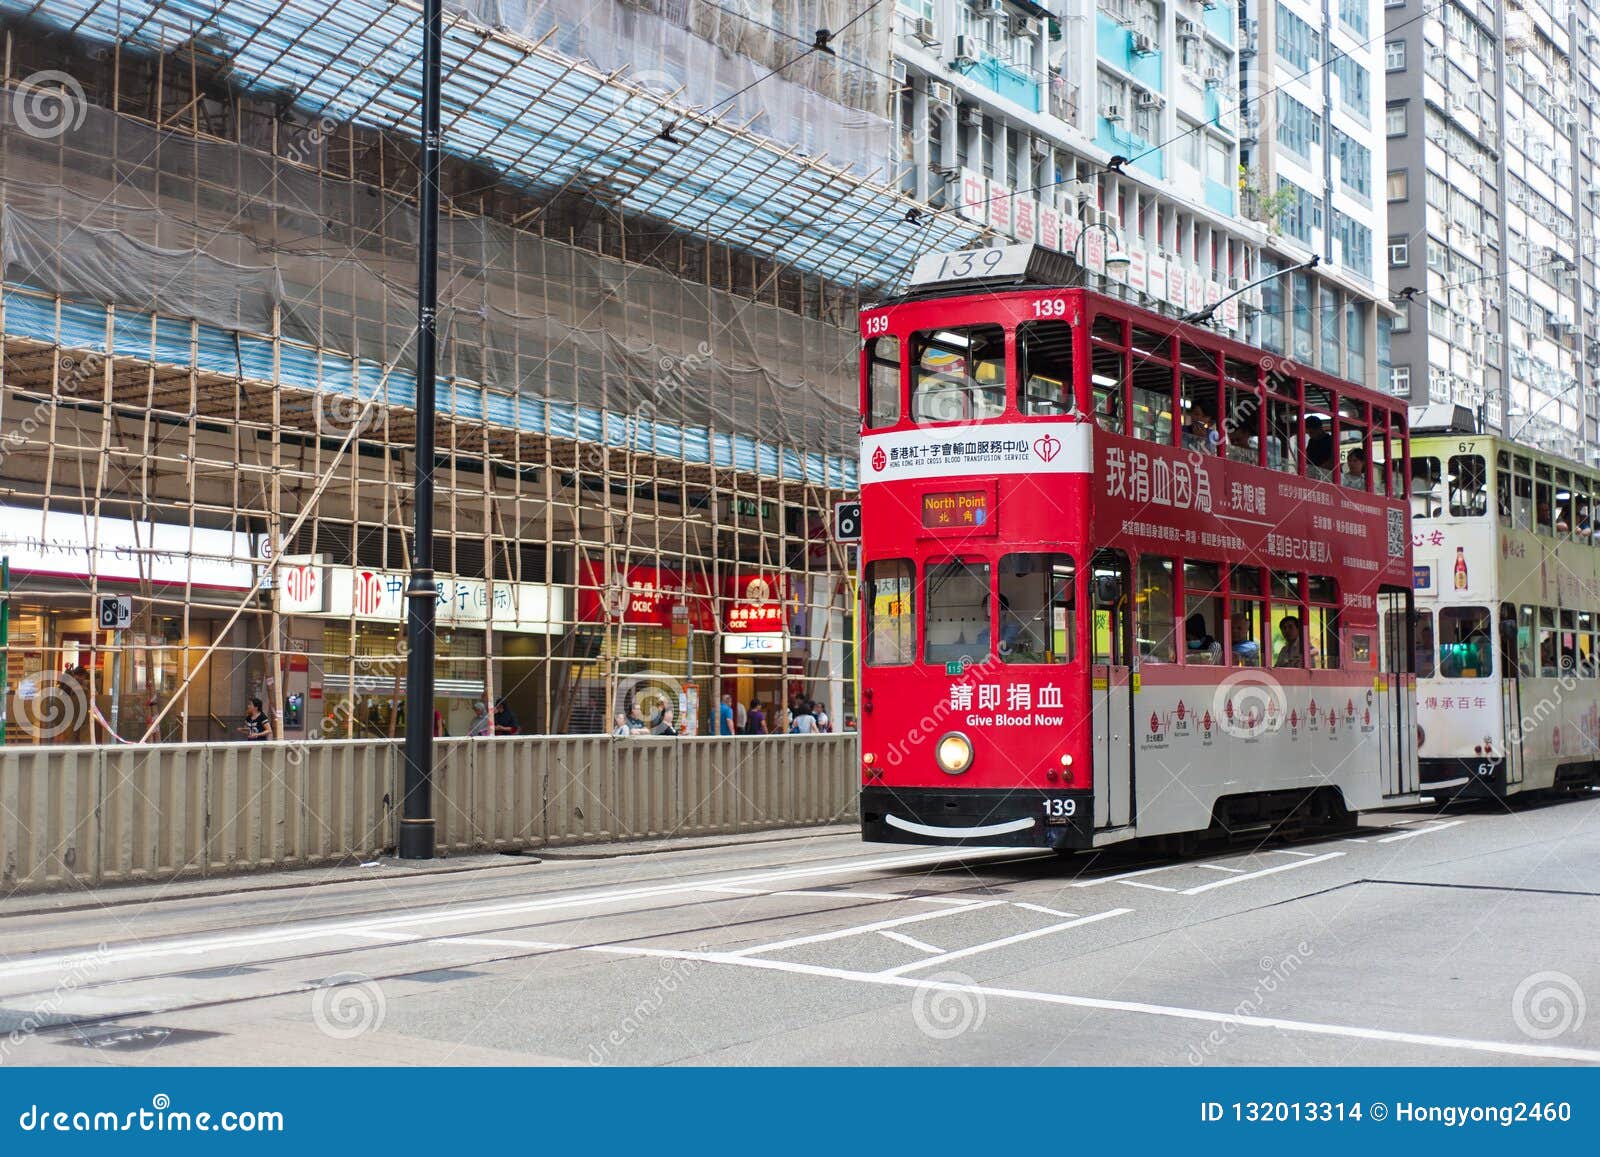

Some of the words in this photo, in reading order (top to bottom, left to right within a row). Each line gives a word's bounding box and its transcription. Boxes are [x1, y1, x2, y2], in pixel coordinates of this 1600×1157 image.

[936, 249, 1004, 280] 139
[1032, 298, 1066, 318] 139
[865, 315, 889, 335] 139
[889, 439, 1030, 461] 香港紅十字會輸血服務中心
[1458, 442, 1476, 453] 67
[890, 460, 901, 468] HONG
[901, 459, 914, 467] KONG
[915, 458, 925, 466] RED
[926, 457, 942, 465] CROSS
[944, 456, 961, 464] BLOOD
[963, 454, 1002, 463] TRANSFUSION
[1004, 453, 1029, 461] SERVICE
[1105, 446, 1214, 513] 我捐血因為
[924, 496, 956, 510] North
[958, 495, 987, 509] Point
[632, 600, 652, 613] OCBC
[729, 620, 748, 629] OCBC
[950, 683, 1064, 712] 請即捐血
[1424, 695, 1487, 711] 傳承百年
[966, 714, 993, 726] Give
[995, 713, 1032, 726] Blood
[1034, 714, 1064, 726] Now
[1478, 763, 1496, 776] 67
[1042, 798, 1077, 817] 139
